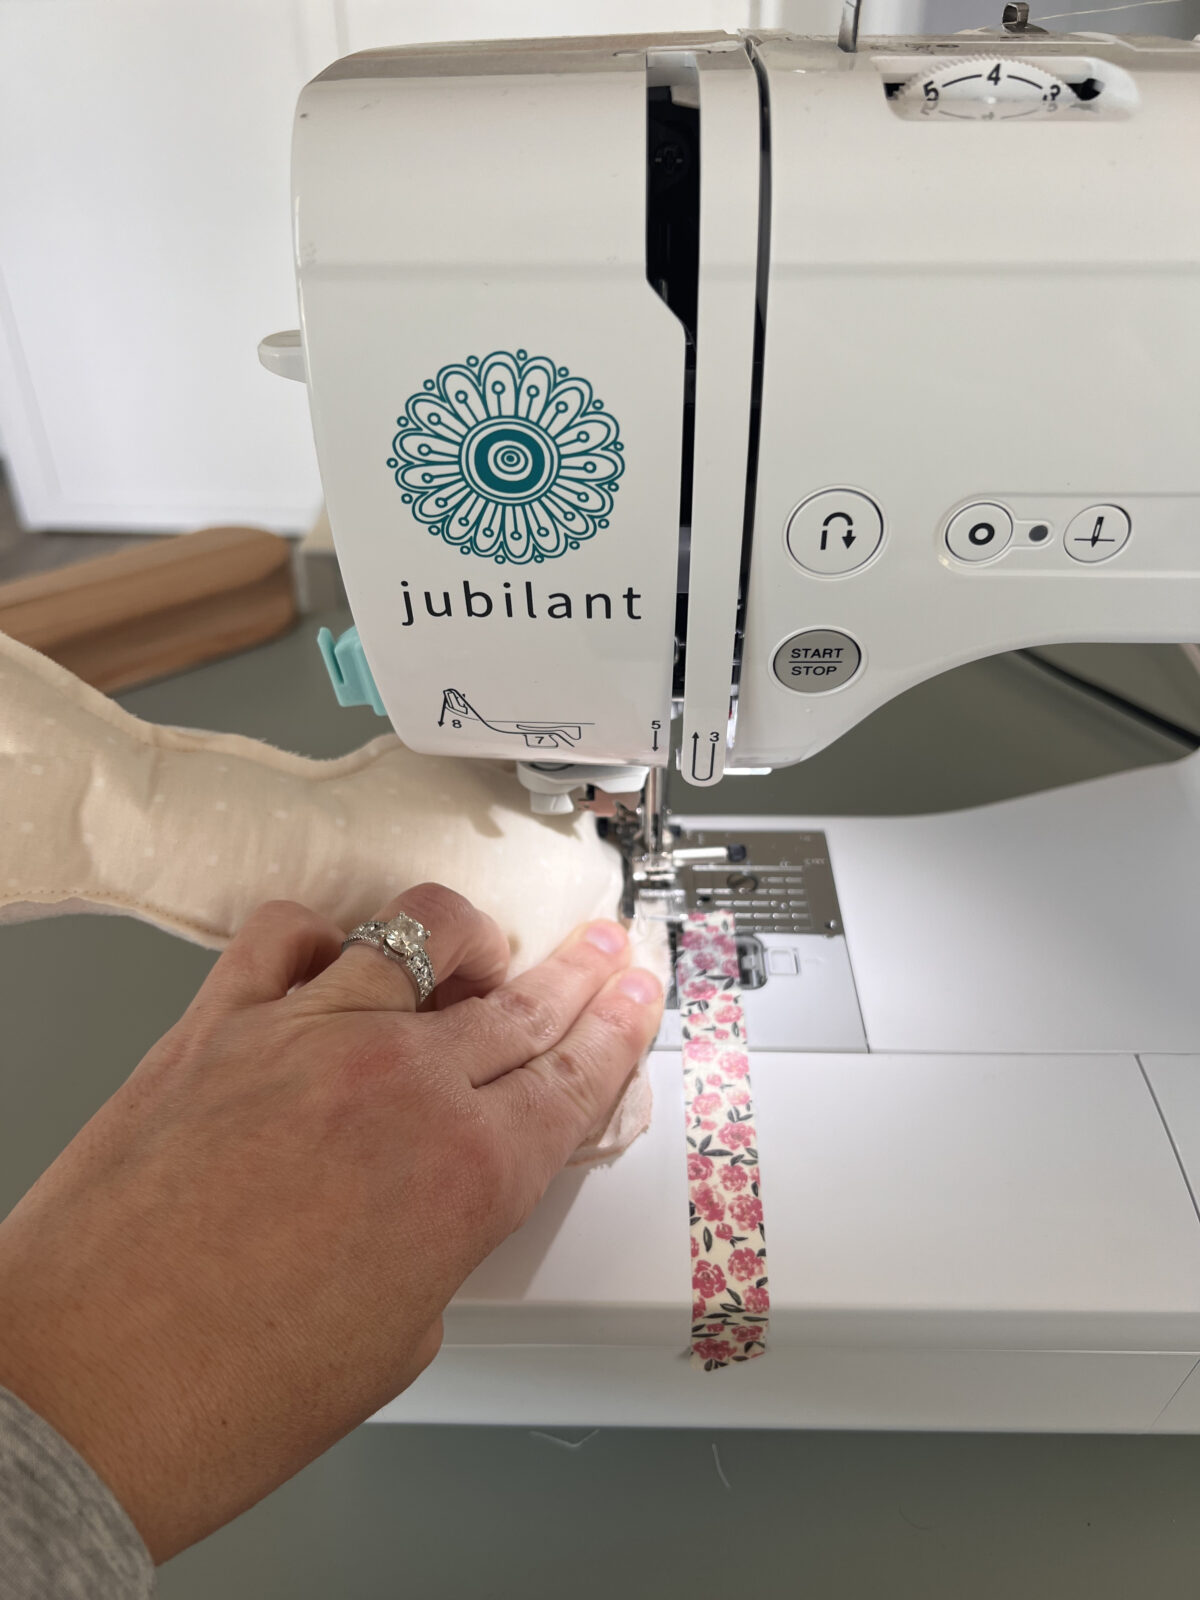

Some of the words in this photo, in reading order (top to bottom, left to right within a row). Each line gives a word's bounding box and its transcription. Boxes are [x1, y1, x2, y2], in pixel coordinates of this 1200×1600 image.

[924, 81, 939, 101] 5
[986, 63, 1001, 86] 4
[401, 580, 641, 626] jubilant
[791, 648, 843, 659] START
[791, 666, 837, 676] STOP
[452, 719, 462, 729] 8
[652, 720, 661, 729] 5
[535, 736, 544, 745] 7
[709, 731, 719, 742] 3
